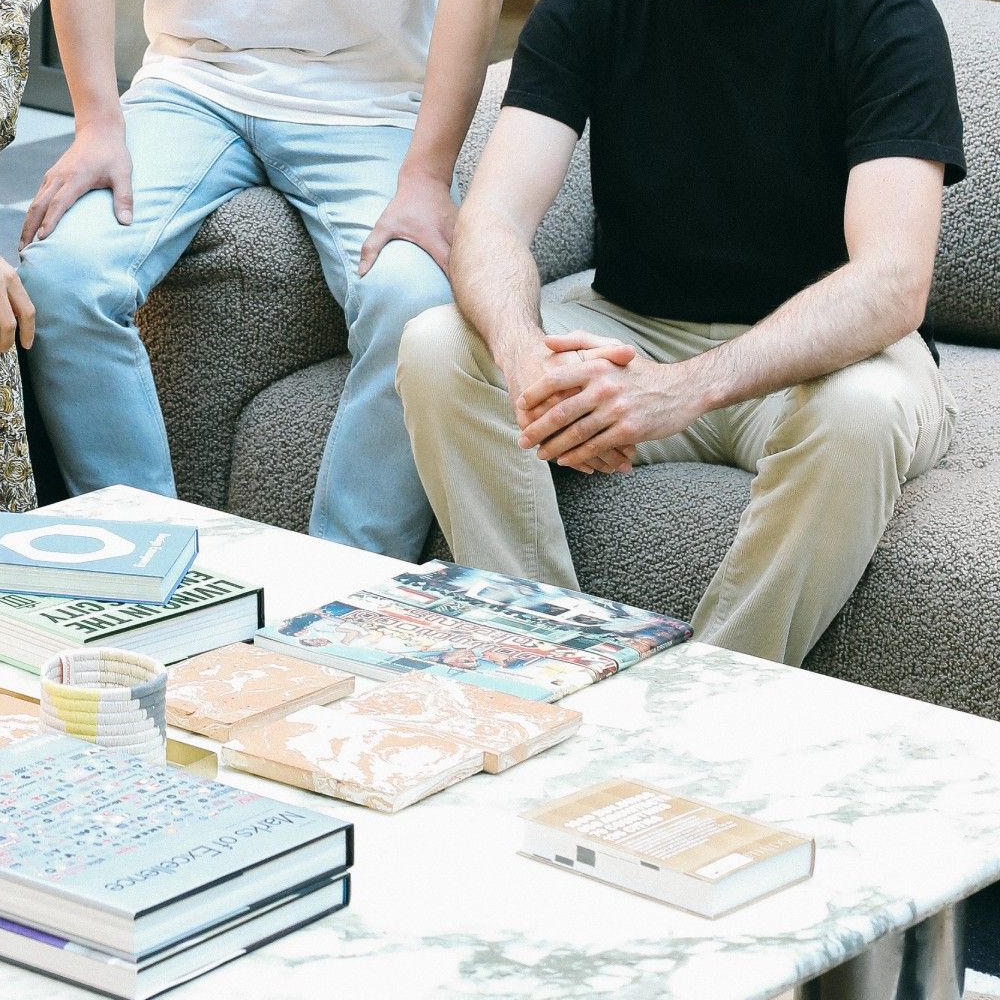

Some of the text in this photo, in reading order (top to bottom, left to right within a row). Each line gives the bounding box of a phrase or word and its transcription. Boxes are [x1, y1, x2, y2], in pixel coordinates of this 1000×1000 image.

[39, 601, 105, 623] CITY
[118, 604, 162, 619] IN
[63, 613, 133, 634] THE
[235, 810, 306, 838] Marks
[218, 835, 238, 850] of
[105, 844, 222, 892] Excellence
